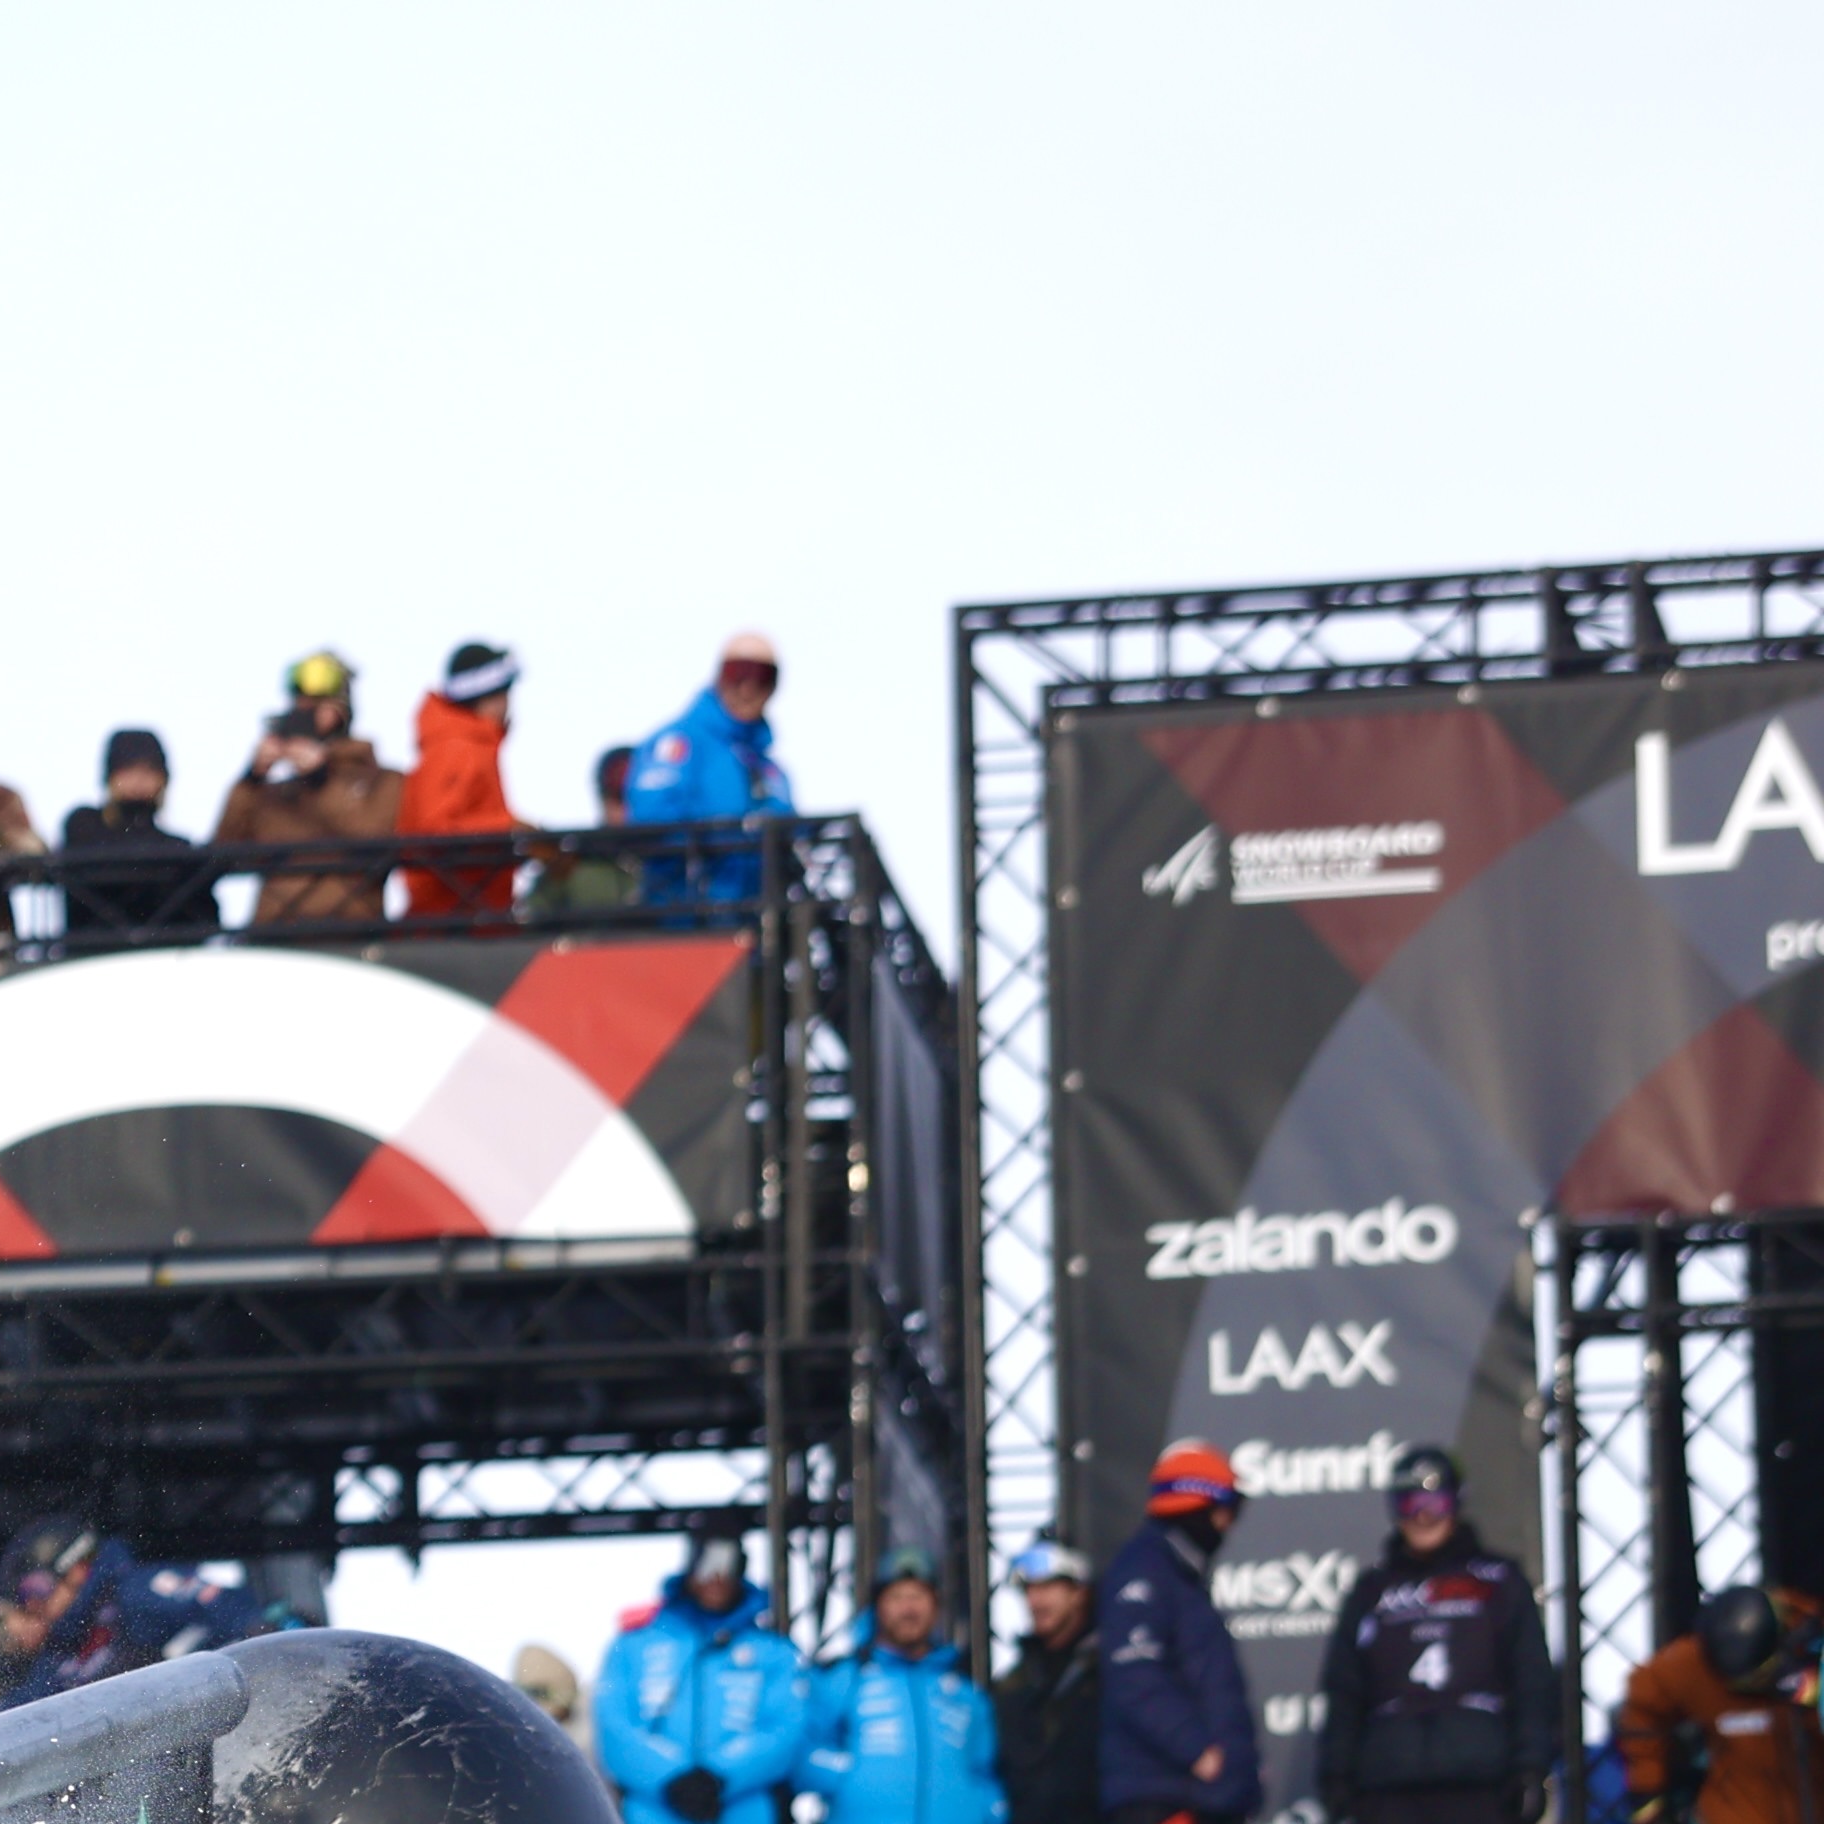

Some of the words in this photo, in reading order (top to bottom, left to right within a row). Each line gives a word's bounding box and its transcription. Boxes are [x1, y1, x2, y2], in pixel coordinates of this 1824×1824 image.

[1229, 820, 1445, 864] SNOWBOARD
[1145, 1196, 1458, 1281] zalando
[1207, 1318, 1398, 1396] LAAX
[1229, 1428, 1408, 1498] Sunri
[1408, 1641, 1451, 1692] 4
